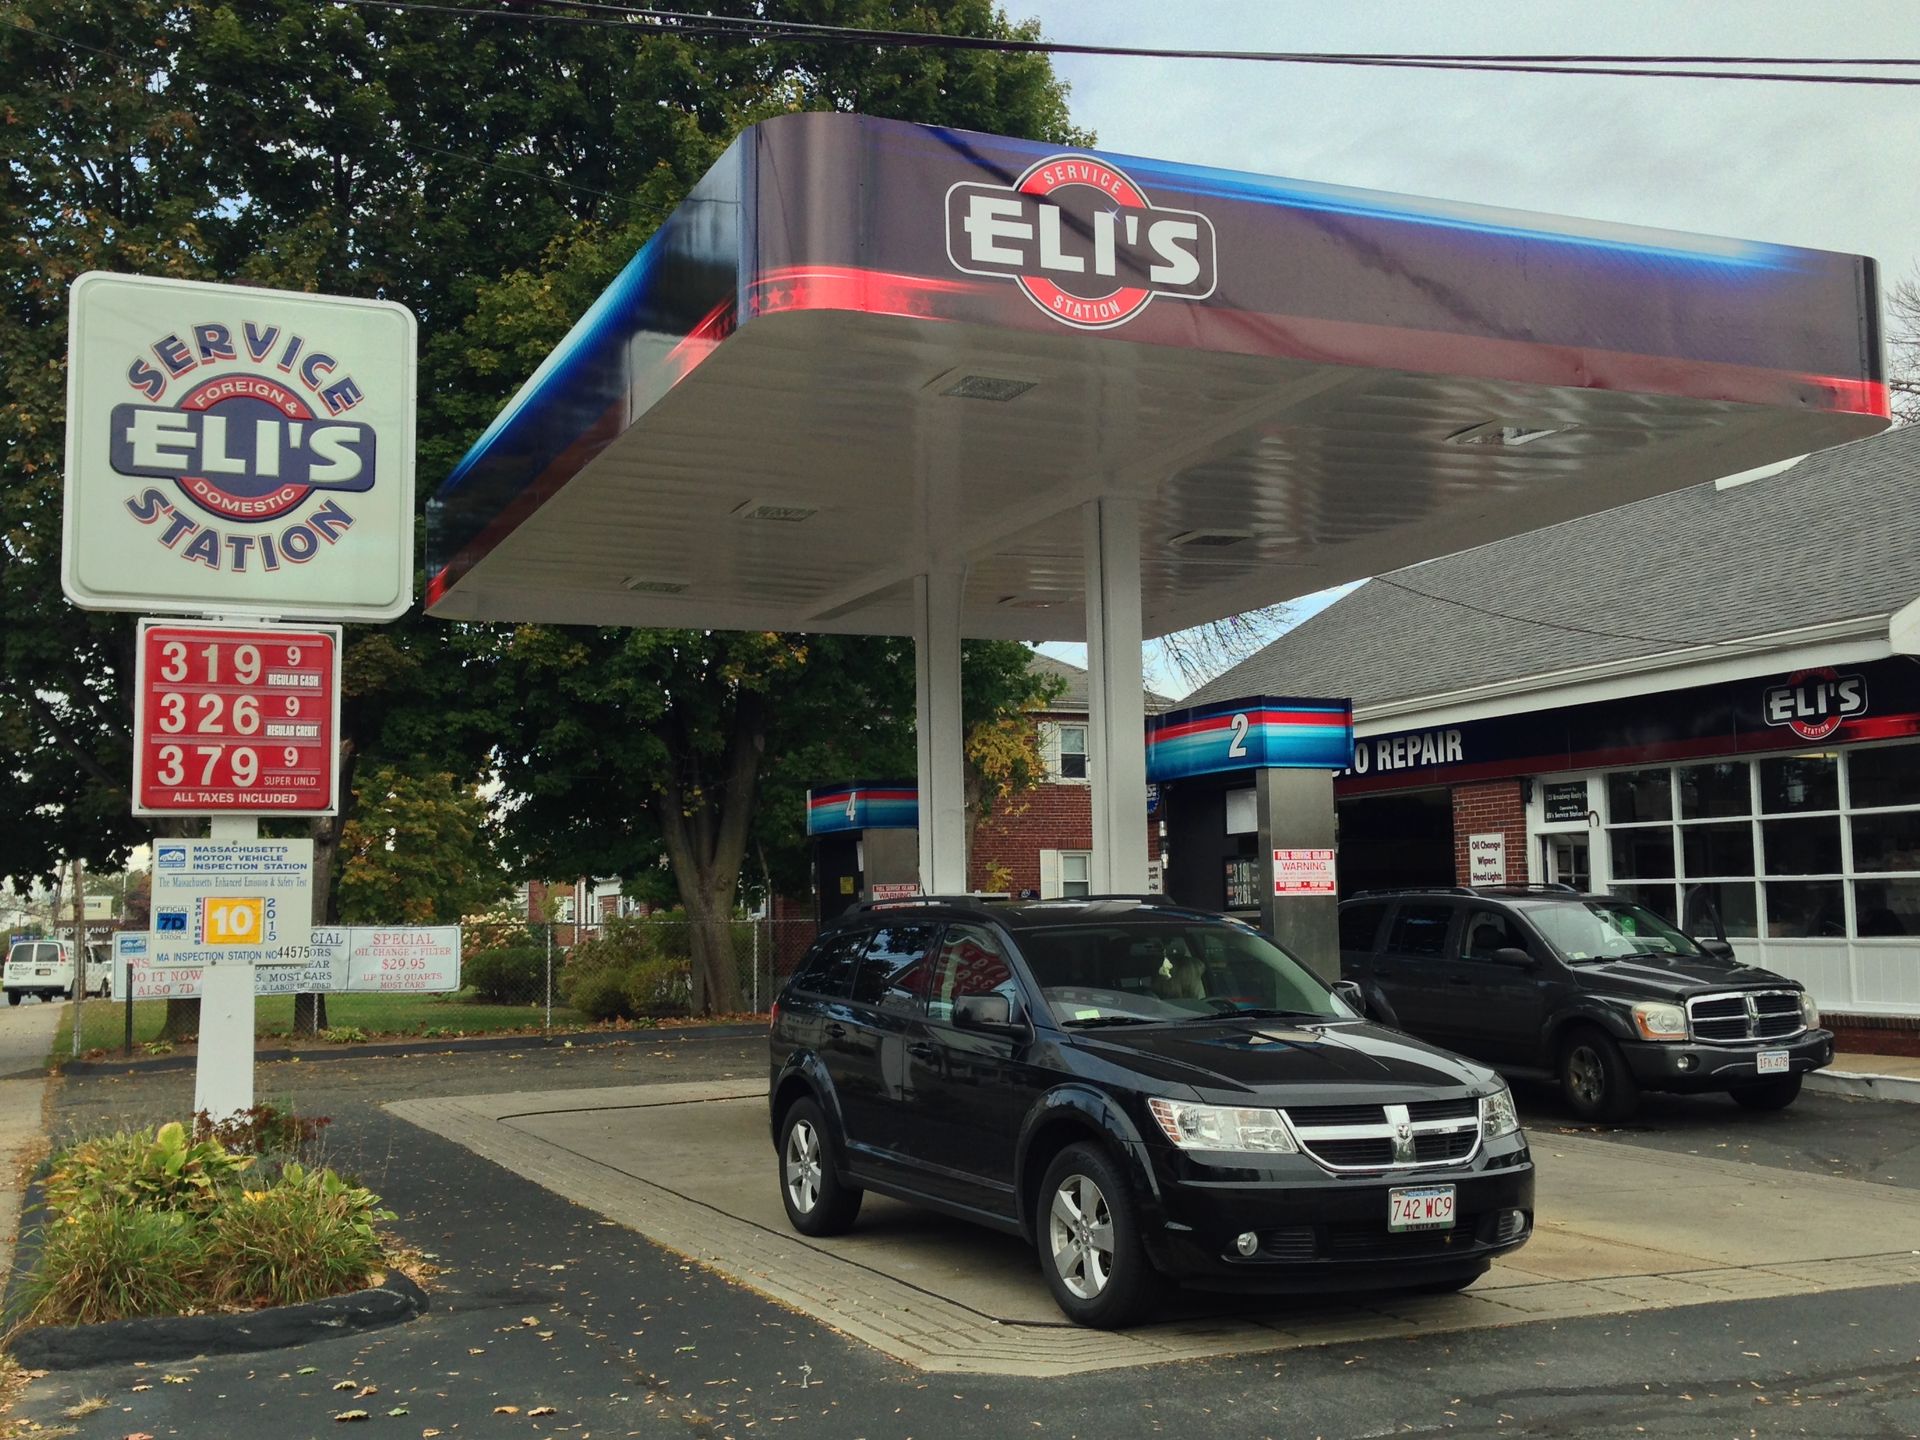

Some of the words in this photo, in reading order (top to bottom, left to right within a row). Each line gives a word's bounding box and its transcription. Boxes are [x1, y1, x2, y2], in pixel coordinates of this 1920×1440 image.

[1044, 165, 1122, 193] SERVICE
[964, 195, 1200, 286] ELI'S
[1053, 295, 1120, 318] STATION
[126, 320, 365, 416] SERVICE
[195, 381, 285, 407] FOREIGN
[285, 401, 298, 414] &
[126, 409, 363, 483] ELI'S
[193, 481, 296, 513] DOMESTIC
[124, 486, 356, 573] STATION
[286, 646, 301, 666] 9
[268, 674, 298, 686] REGULAR
[300, 674, 319, 687] CASH
[285, 696, 300, 716] 9
[1770, 680, 1860, 720] ELI'S
[266, 725, 295, 736] REGULAR
[296, 725, 318, 737] CREDIT
[1228, 713, 1249, 758] 2
[1803, 724, 1829, 735] STATION
[284, 746, 299, 767] 9
[1377, 729, 1463, 771] REPAIR
[264, 776, 291, 786] SUPER
[294, 777, 316, 786] UNLD
[173, 792, 197, 802] ALL
[198, 792, 234, 803] TAXES
[239, 793, 297, 804] INCLUDED
[845, 792, 856, 821] 4
[1472, 841, 1480, 850] Oil
[1481, 841, 1500, 851] Change
[1282, 862, 1326, 870] WARNING
[1477, 857, 1496, 867] Wipers
[159, 877, 171, 887] The
[172, 877, 212, 887] Massachusetts
[215, 877, 242, 887] Enhanced
[244, 877, 268, 887] Emission
[277, 877, 294, 888] Safety
[296, 877, 307, 887] Test
[1473, 872, 1487, 881] Head
[159, 917, 185, 931] 7D
[212, 905, 254, 936] 10
[267, 898, 277, 942] 2015
[373, 933, 435, 945] SPECIAL
[156, 953, 168, 961] MA
[174, 952, 224, 961] INSPECTION
[228, 951, 262, 960] STATION
[278, 946, 310, 959] 44575
[373, 948, 410, 956] CHANGE
[420, 947, 452, 956] FILTER
[381, 959, 425, 970] $29.95
[152, 971, 165, 982] IT
[170, 970, 203, 981] NOW
[269, 973, 301, 982] MOST
[304, 972, 332, 981] CARS
[363, 973, 376, 981] UP
[380, 973, 392, 981] TO
[396, 973, 401, 981] 5
[404, 972, 442, 981] QUARTS
[137, 984, 170, 995] ALSO
[179, 983, 194, 994] 7D
[380, 981, 402, 989] MOST
[405, 981, 426, 989] CARS
[1394, 1199, 1420, 1221] 742
[1426, 1197, 1452, 1218] WC9
